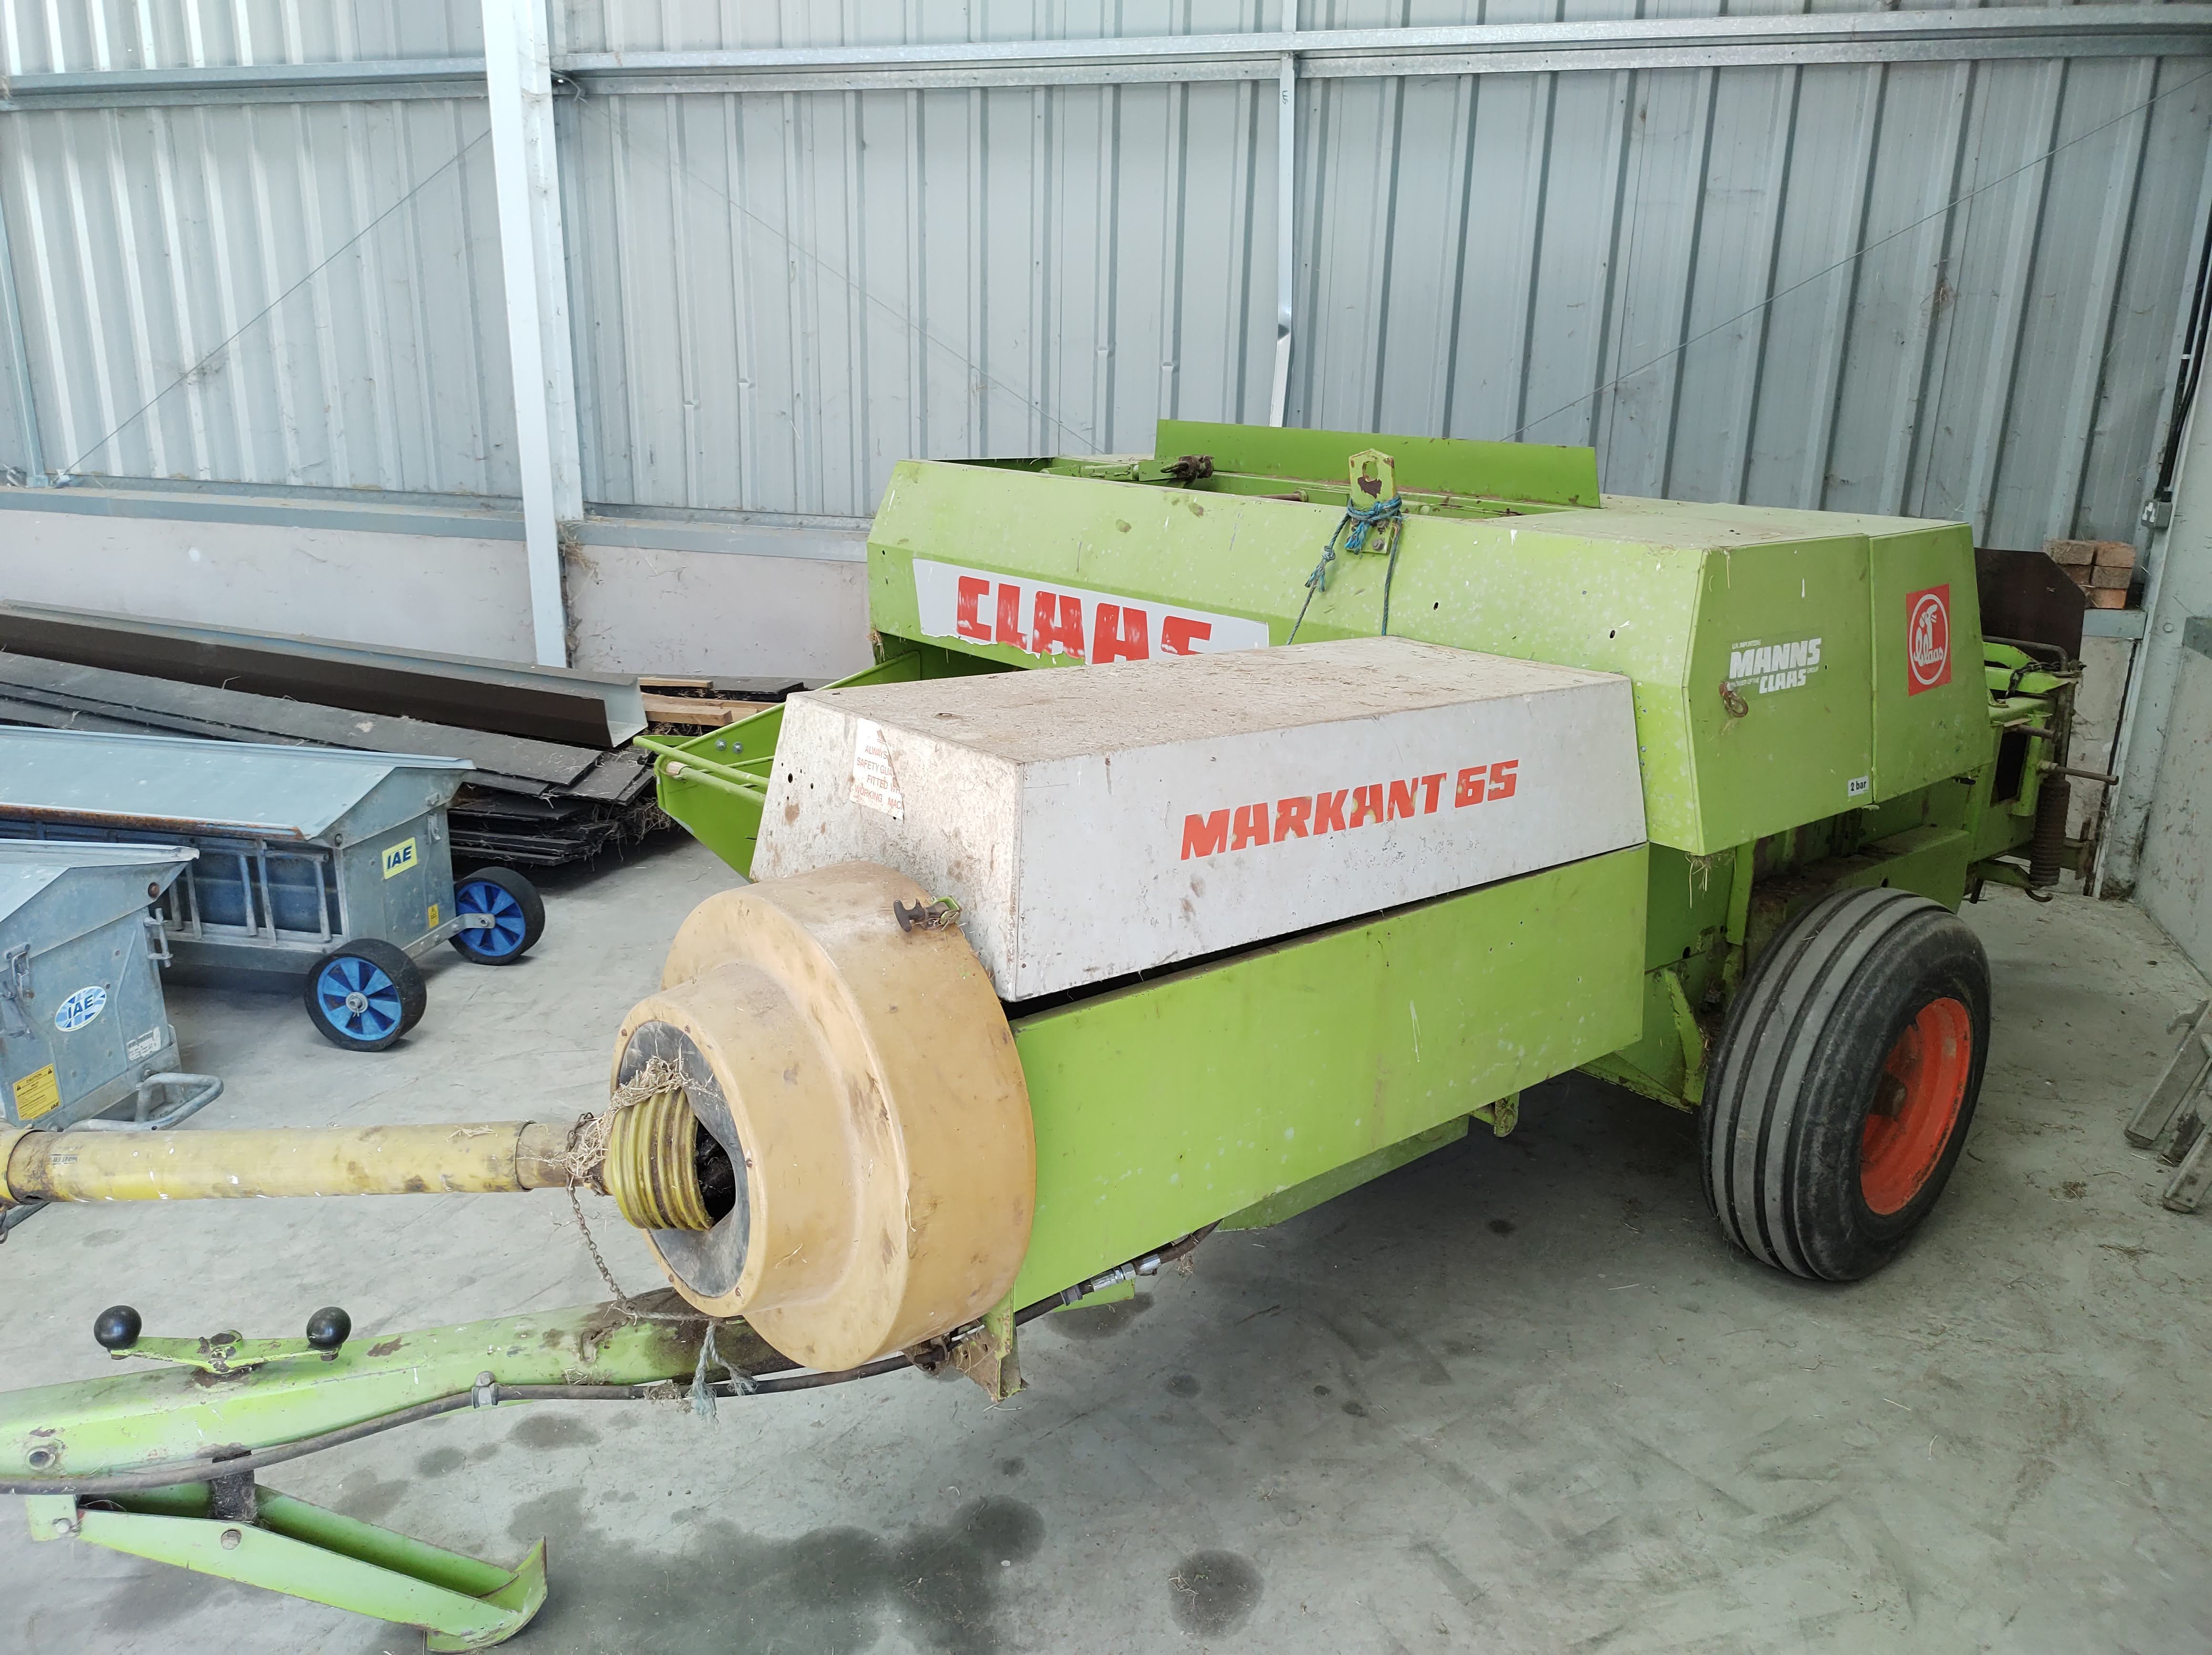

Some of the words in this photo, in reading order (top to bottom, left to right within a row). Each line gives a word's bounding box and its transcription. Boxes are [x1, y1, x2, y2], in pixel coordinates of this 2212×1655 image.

[1729, 638, 1822, 679] MANNS
[1759, 669, 1807, 694] CLAAS
[865, 745, 887, 759] ALWAYS
[857, 757, 879, 772] SAFETY
[867, 774, 888, 789] FITTED
[1850, 782, 1855, 791] 2
[1856, 780, 1867, 790] bar
[855, 784, 883, 803] WORKING
[1180, 772, 1447, 861] MARKANT
[1454, 759, 1519, 808] 65
[387, 845, 412, 870] IAE
[68, 994, 93, 1019] IAE
